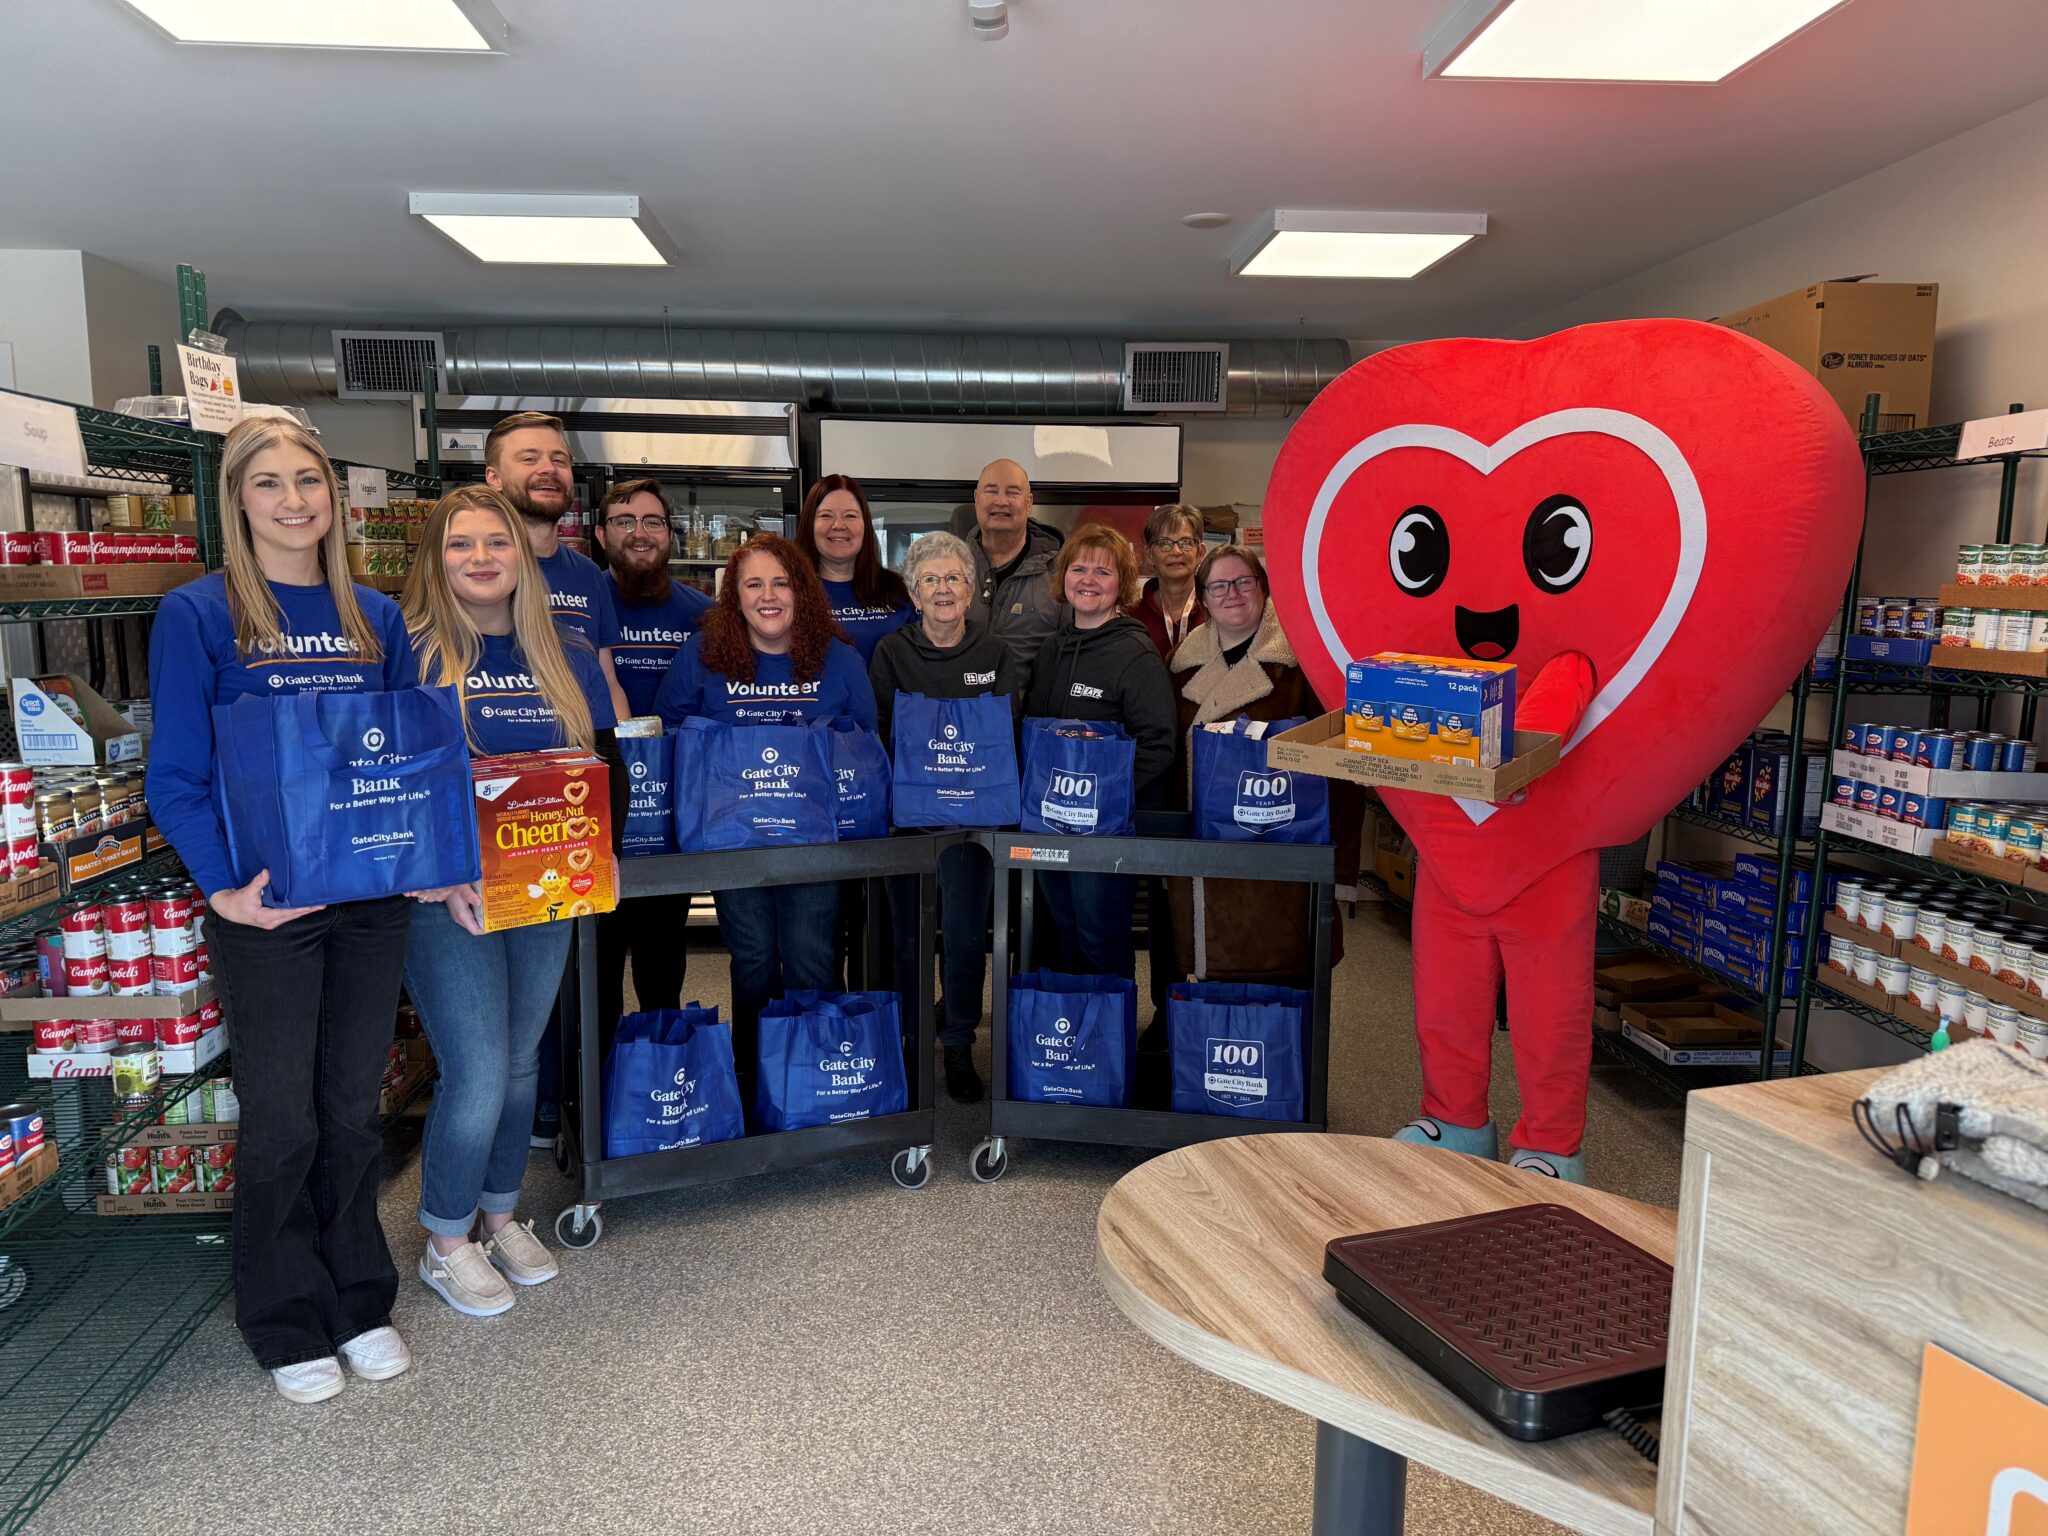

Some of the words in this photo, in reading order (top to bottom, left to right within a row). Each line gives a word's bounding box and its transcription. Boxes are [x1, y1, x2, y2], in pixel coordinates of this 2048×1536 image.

[187, 352, 221, 374] Birthday
[1848, 353, 1868, 361] HONEY
[1870, 353, 1898, 361] BUNCHES
[1847, 361, 1873, 369] ALMOND
[190, 371, 209, 390] Bags
[24, 423, 48, 443] Soup
[1988, 435, 2015, 448] Beans
[361, 483, 377, 495] Veggies
[842, 607, 865, 616] City
[620, 626, 691, 642] lunteer
[642, 658, 656, 666] City
[285, 675, 311, 684] Gate
[313, 674, 335, 685] City
[336, 674, 364, 683] Bank
[978, 674, 996, 684] EATS
[726, 681, 820, 695] Volunteer
[1448, 682, 1456, 690] 12
[1458, 683, 1478, 693] pack
[22, 698, 40, 707] Great
[495, 707, 517, 716] Gate
[518, 707, 538, 717] City
[765, 710, 782, 718] City
[928, 739, 953, 750] Gate
[953, 741, 975, 754] City
[937, 753, 968, 764] Bank
[1343, 757, 1367, 766] CANNED
[1383, 764, 1408, 772] SALMON
[741, 768, 772, 779] Gate
[774, 765, 800, 777] City
[351, 777, 401, 795] Bank
[641, 781, 667, 795] City
[754, 778, 790, 790] Bank
[1052, 774, 1092, 797] 100
[1242, 776, 1287, 797] 100
[353, 798, 377, 807] Better
[378, 796, 395, 804] Way
[397, 793, 407, 801] of
[507, 800, 537, 810] Limited
[537, 796, 565, 806] Edition
[629, 795, 657, 808] ank
[530, 809, 563, 822] Honey
[566, 806, 584, 817] Nut
[1051, 807, 1063, 816] Gate
[1063, 810, 1077, 818] City
[1275, 807, 1291, 815] Bank
[753, 817, 796, 825] GateCity.Bank
[351, 830, 414, 845] GateCity.Bank
[564, 841, 588, 849] SHAPES
[74, 859, 101, 873] ROASTED
[102, 854, 120, 866] TURKEY
[120, 846, 138, 857] GRAVY
[1736, 862, 1759, 877] RONZONI
[1658, 870, 1679, 884] RONZONI
[1721, 890, 1745, 906] RONZONI
[1649, 922, 1670, 938] RONZONI
[1705, 918, 1727, 935] RONZONI
[1704, 947, 1725, 964] RONZONI
[1036, 1033, 1062, 1047] Gate
[1212, 1044, 1258, 1066] 100
[820, 1059, 849, 1071] Gate
[850, 1057, 876, 1071] City
[832, 1072, 866, 1086] Bank
[1232, 1079, 1245, 1087] City
[1246, 1080, 1263, 1088] Bank
[651, 1089, 680, 1101] Gate
[1043, 1085, 1082, 1094] GateCity.Bank
[829, 1109, 870, 1120] GateCity.Bank
[147, 1131, 171, 1140] Hunt's
